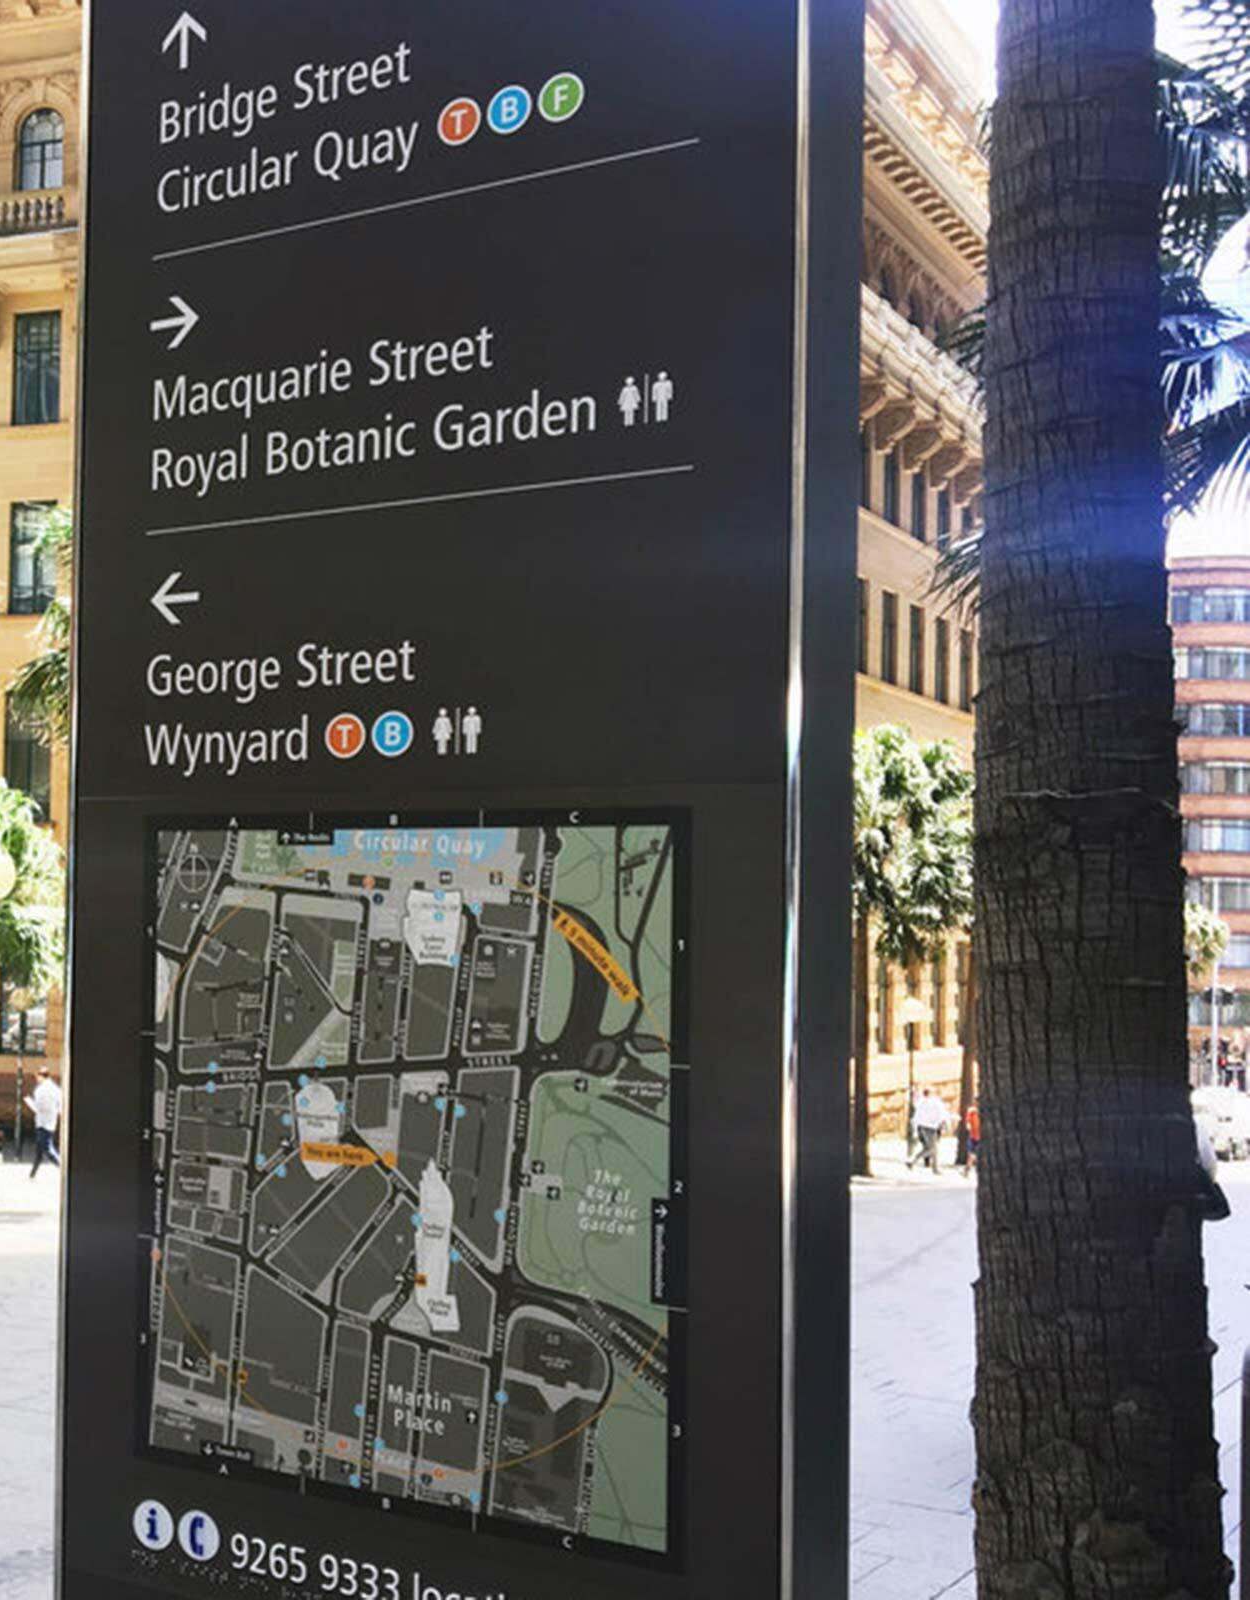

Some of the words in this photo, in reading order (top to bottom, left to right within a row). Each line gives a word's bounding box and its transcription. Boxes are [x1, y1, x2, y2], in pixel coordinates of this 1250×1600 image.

[159, 82, 278, 144] Bridge
[293, 42, 412, 110] Street
[157, 146, 299, 213] Circular
[313, 121, 419, 180] Quay
[153, 351, 353, 421] Macquarie
[369, 326, 494, 386] Street
[151, 434, 249, 497] Royal
[265, 413, 417, 475] Botanic
[433, 388, 597, 451] Garden
[146, 654, 281, 704] George
[297, 640, 416, 688] Street
[144, 714, 309, 777] Wynyard
[229, 816, 239, 828] A
[569, 811, 579, 824] C
[354, 829, 430, 852] Circular
[436, 834, 487, 860] Quay
[607, 969, 633, 997] walk
[467, 1057, 511, 1068] STREET
[306, 1145, 325, 1160] You
[342, 1149, 364, 1161] here
[593, 1169, 622, 1186] The
[674, 1180, 683, 1194] 2
[585, 1184, 631, 1204] Royal
[577, 1200, 639, 1220] Botanic
[579, 1216, 636, 1236] Garden
[387, 1383, 453, 1414] Martin
[393, 1408, 446, 1437] Place
[671, 1423, 682, 1438] 3
[219, 1463, 229, 1476] A
[562, 1535, 574, 1550] C
[230, 1532, 308, 1584] 9265
[319, 1553, 400, 1600] 9333
